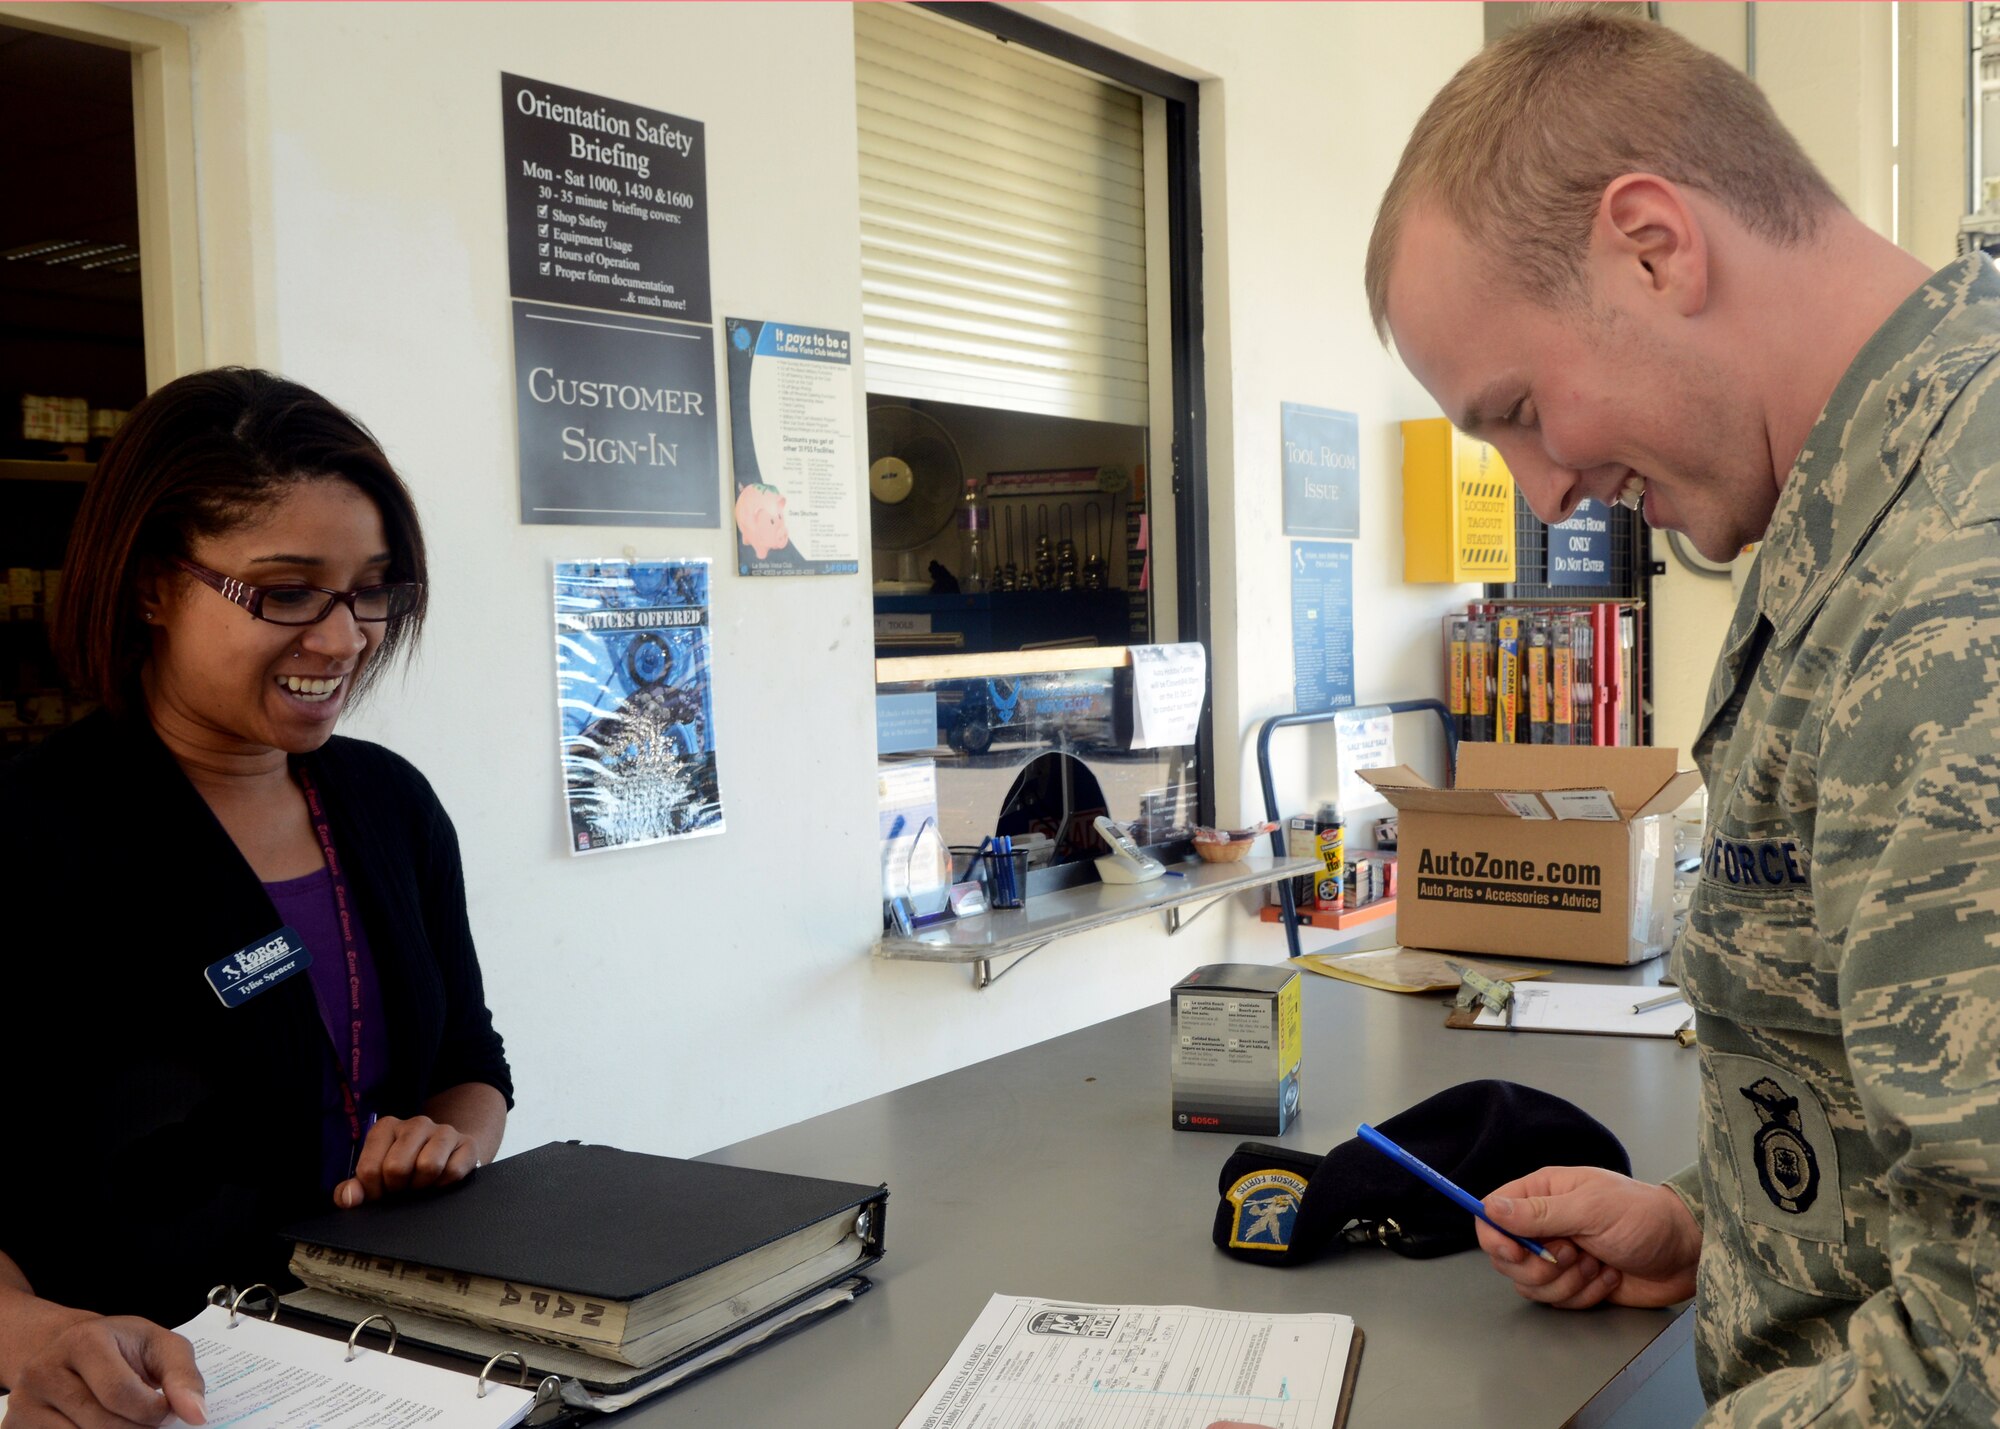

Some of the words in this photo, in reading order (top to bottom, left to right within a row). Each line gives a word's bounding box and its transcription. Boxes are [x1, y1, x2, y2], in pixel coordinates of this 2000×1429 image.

[517, 90, 630, 138] Orientation
[636, 118, 693, 157] Safety
[570, 133, 651, 178] Briefing
[522, 160, 553, 181] Mon
[565, 169, 586, 187] Sat
[589, 174, 621, 196] 1000,
[625, 182, 652, 200] 1430
[539, 186, 552, 199] 30
[561, 190, 573, 203] 35
[575, 194, 608, 210] minute
[612, 200, 648, 221] briefing
[650, 211, 681, 224] covers:
[552, 209, 577, 226] Shop
[579, 214, 608, 232] Safety
[553, 228, 603, 251] Equipment
[605, 237, 633, 254] Usage
[554, 246, 582, 263] Hours
[584, 252, 596, 264] of
[597, 254, 640, 272] Operation
[555, 265, 586, 282] Proper
[588, 270, 610, 285] form
[612, 275, 674, 294] documentation
[638, 294, 661, 308] much
[663, 299, 686, 311] more!
[776, 328, 784, 341] It
[786, 333, 812, 347] pays
[814, 335, 824, 346] to
[826, 335, 839, 348] be
[841, 340, 848, 350] a
[800, 346, 814, 355] Vista
[815, 348, 826, 356] Club
[1286, 442, 1317, 465] TOOL
[1321, 446, 1356, 470] ROOM
[1304, 478, 1339, 500] ISSUE
[1465, 500, 1504, 514] LOCKOUT
[1468, 517, 1502, 529] TAGOUT
[1586, 518, 1606, 532] ROOM
[1466, 534, 1503, 546] STATION
[1569, 536, 1591, 552] ONLY
[638, 610, 701, 627] OFFERED
[1418, 848, 1601, 886] AutoZone.com
[1714, 838, 1807, 885] FORCE
[1420, 882, 1444, 898] Auto
[1446, 885, 1474, 900] Parts
[1485, 888, 1550, 905] Accessories
[1562, 893, 1599, 909] Advice
[239, 978, 264, 994] Tylise
[263, 961, 296, 981] Spencer
[1191, 1116, 1220, 1126] BOSCH
[1237, 1176, 1266, 1195] FORTIS
[1271, 1176, 1306, 1195] FENSOR
[500, 1282, 606, 1327] NAPA
[933, 1390, 955, 1415] CENTER
[949, 1376, 963, 1393] FEES
[963, 1344, 987, 1370] CHARGES
[942, 1408, 960, 1426] Hobby
[978, 1357, 993, 1375] Order
[988, 1345, 1003, 1360] Form
